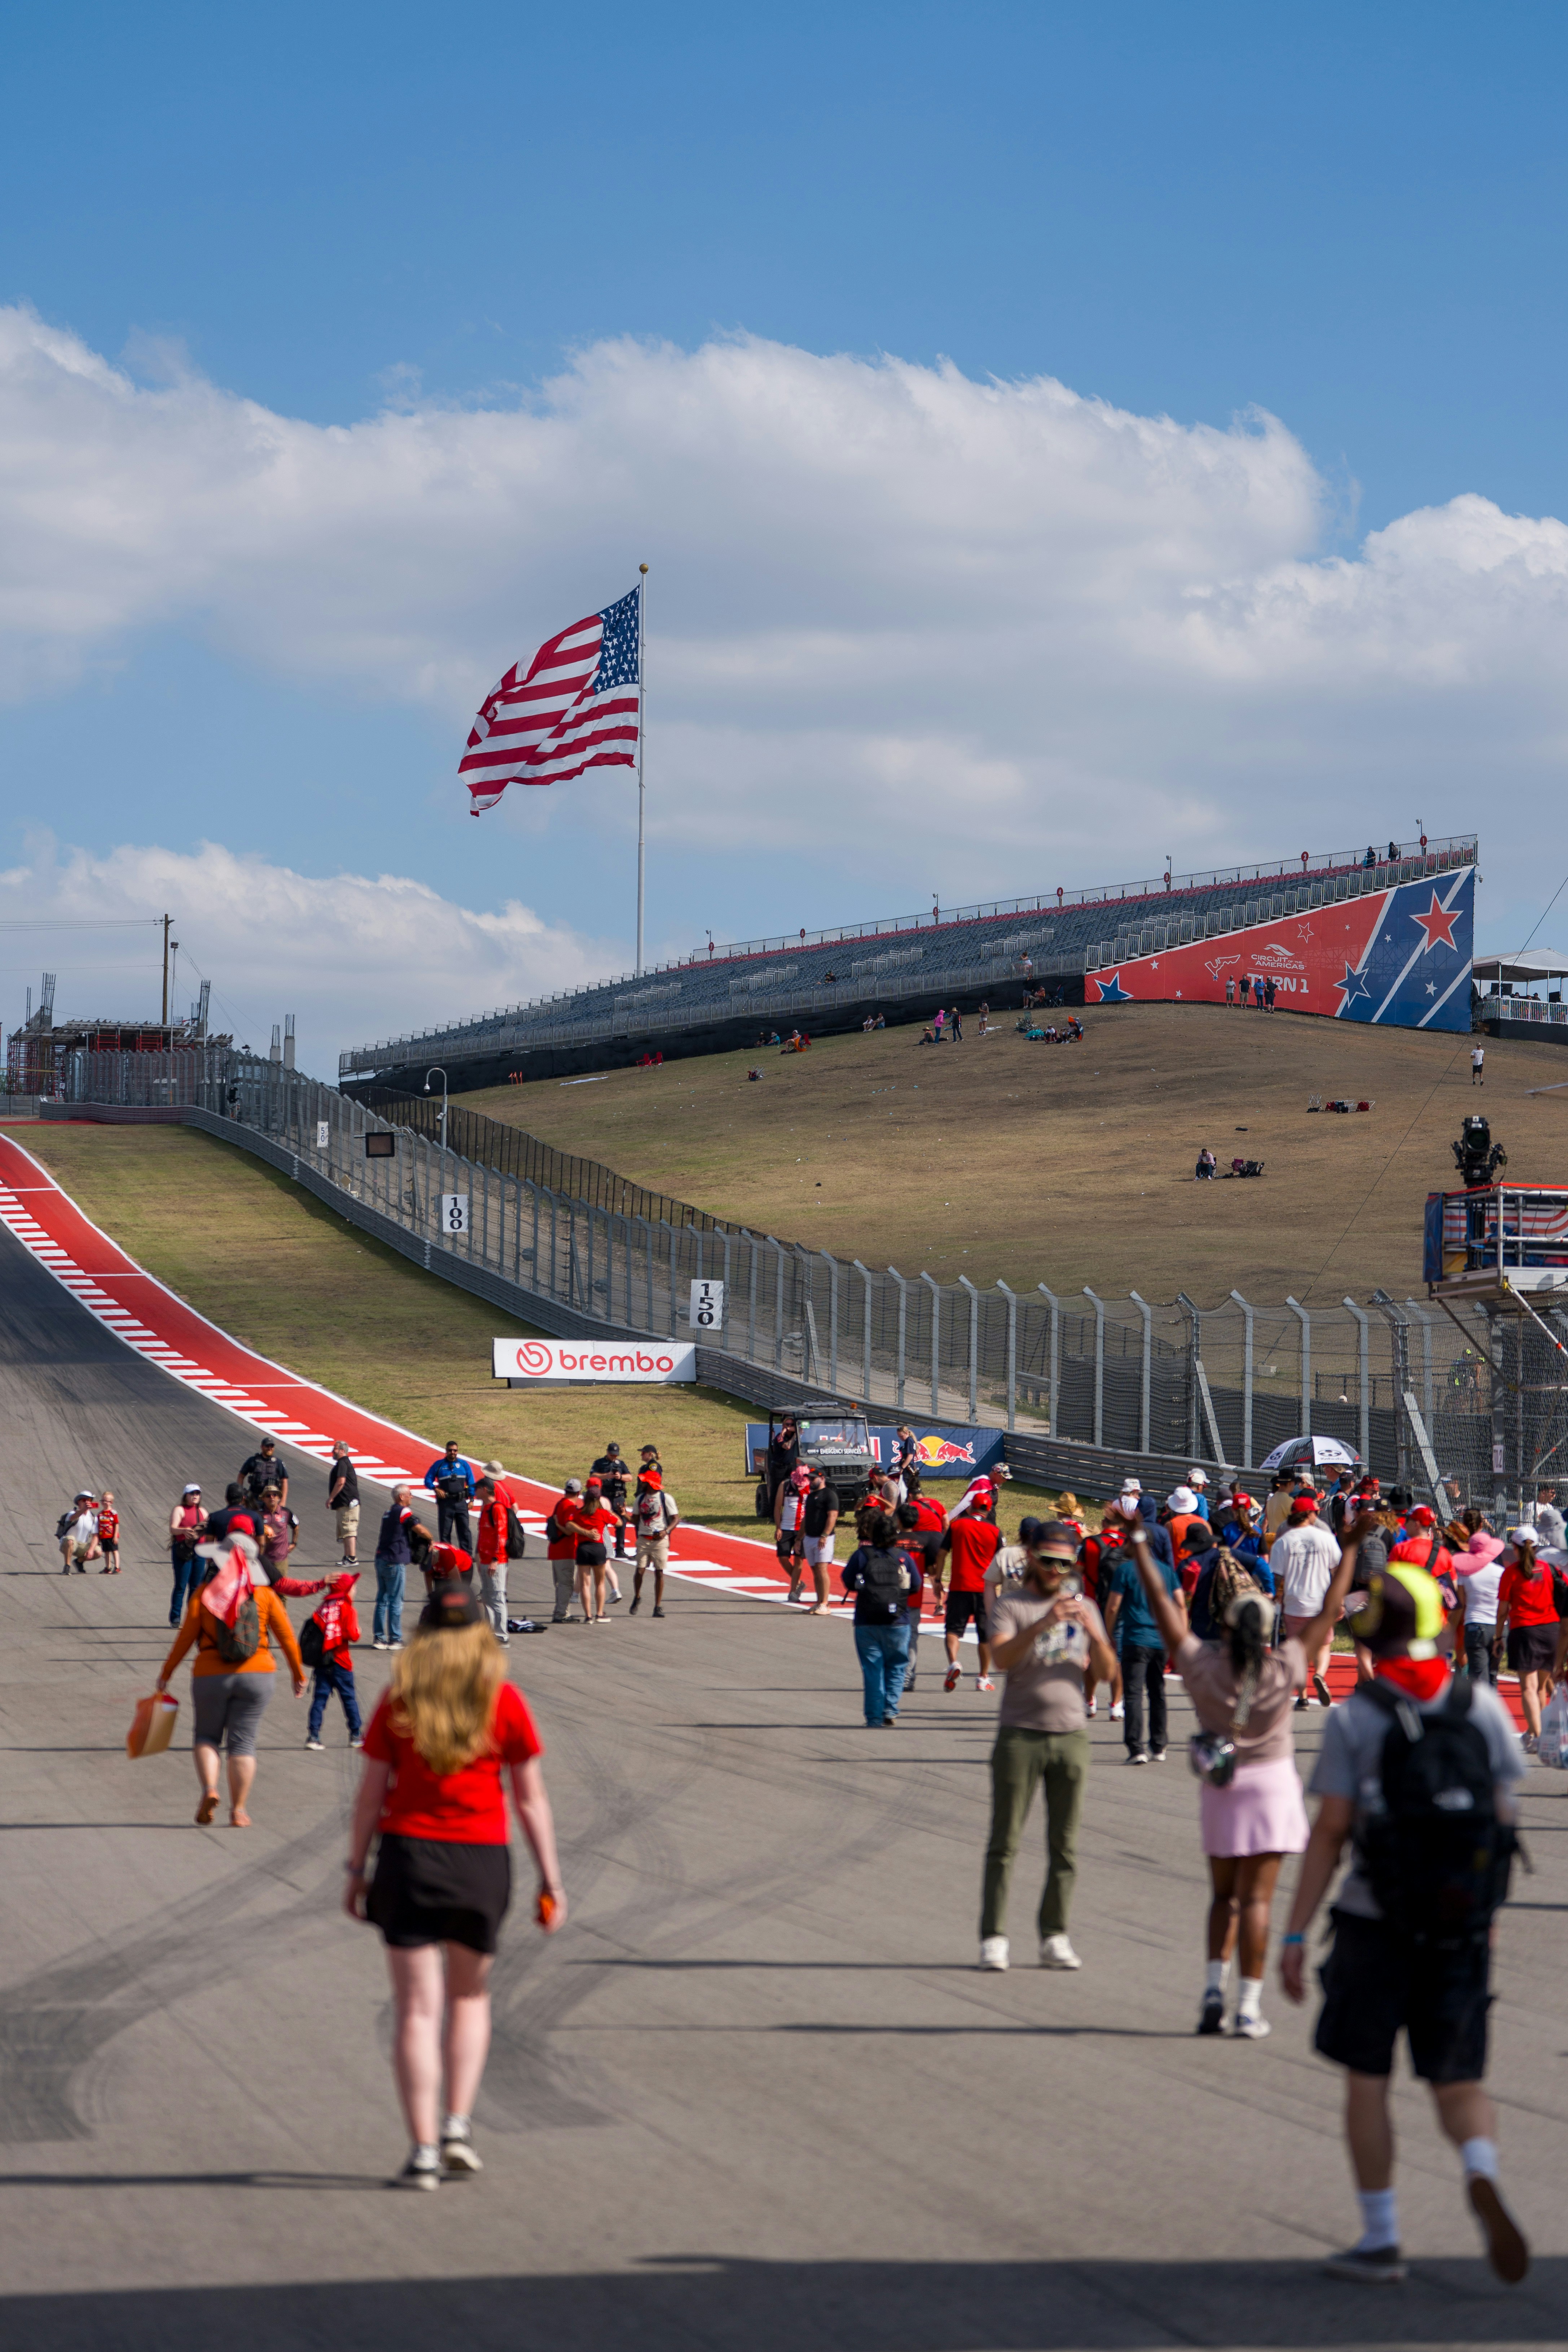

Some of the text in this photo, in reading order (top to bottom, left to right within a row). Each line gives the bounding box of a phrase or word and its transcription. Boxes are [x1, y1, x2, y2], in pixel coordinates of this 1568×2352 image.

[1251, 954, 1288, 962] CIRCUIT
[1255, 960, 1305, 970] AMERICAS
[1247, 973, 1309, 993] TRN 1
[321, 1127, 325, 1142] 50
[449, 1197, 462, 1230] 100
[697, 1283, 714, 1326] 150
[559, 1349, 673, 1372] brembo
